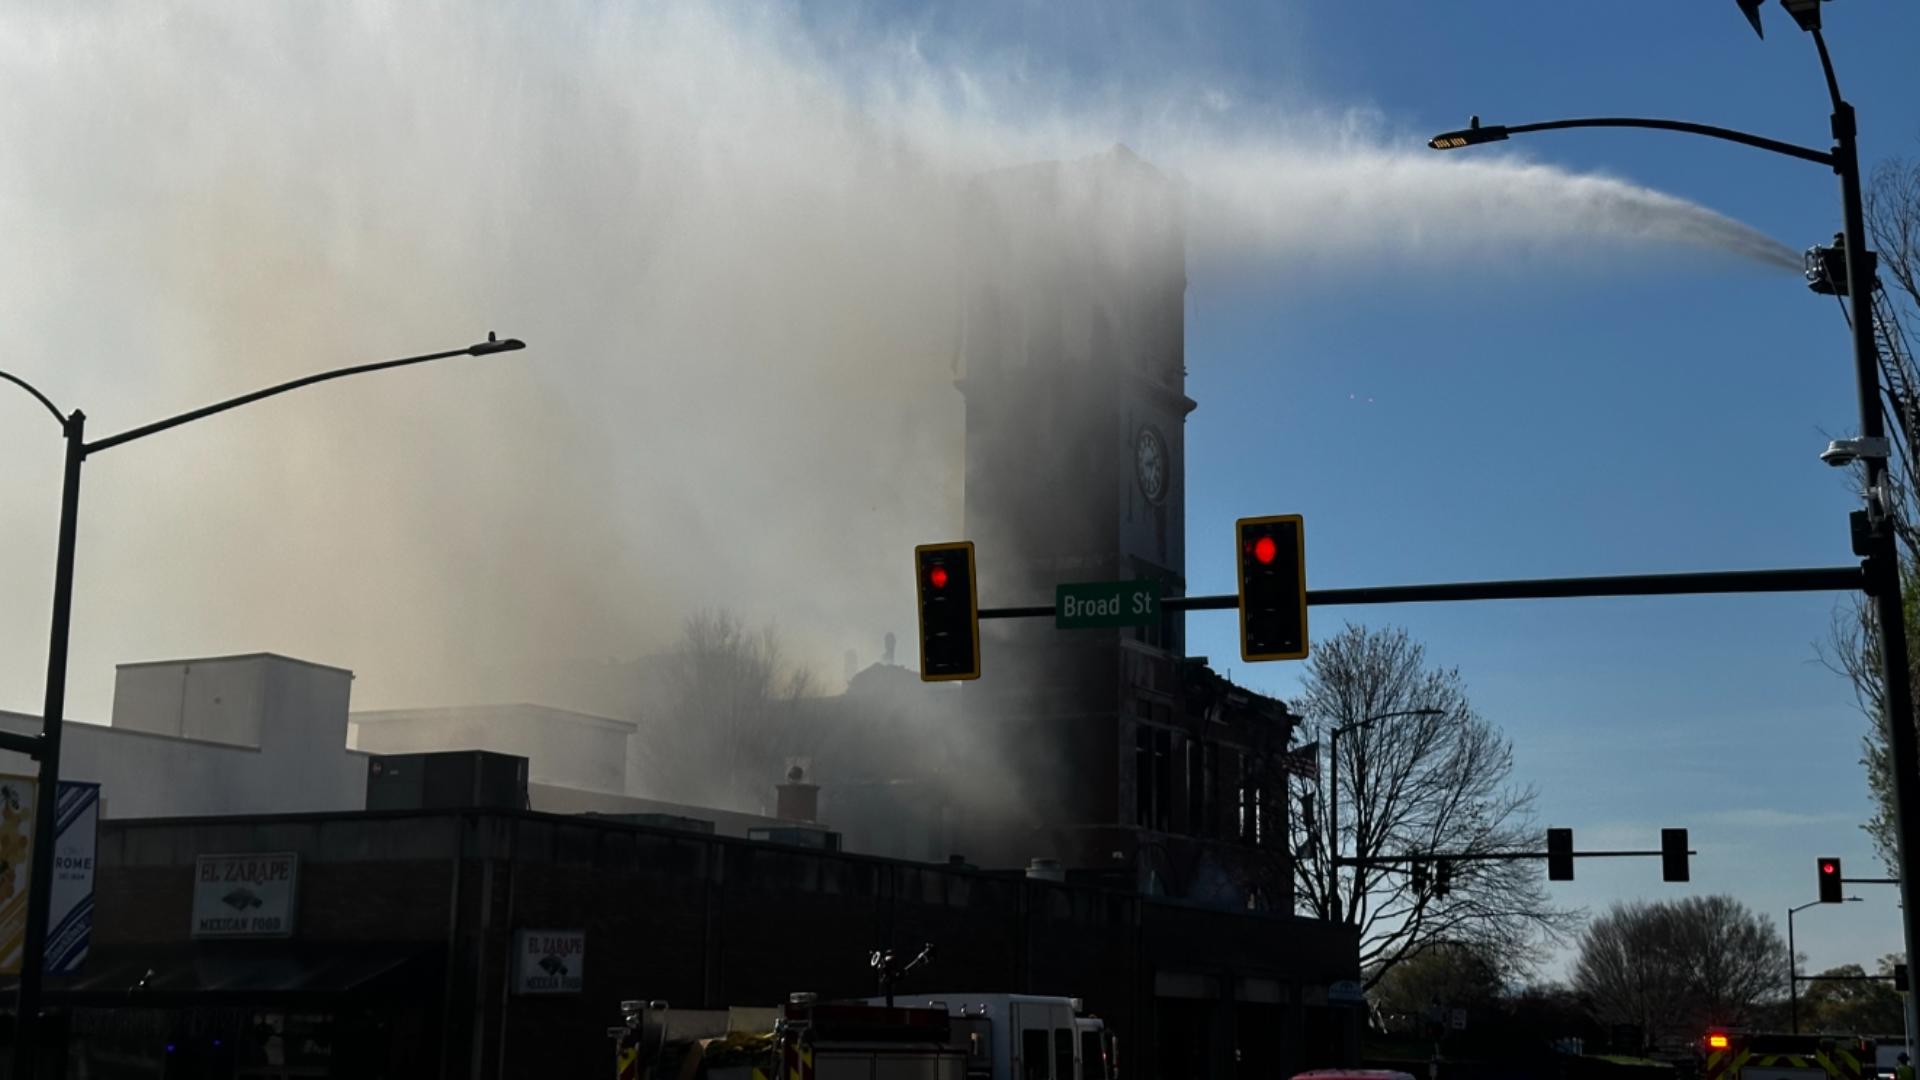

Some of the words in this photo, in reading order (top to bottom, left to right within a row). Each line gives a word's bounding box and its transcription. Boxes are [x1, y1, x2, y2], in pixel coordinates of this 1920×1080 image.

[1063, 593, 1120, 617] Broad
[1131, 591, 1152, 615] St
[55, 856, 92, 870] ROME
[200, 863, 220, 881] EL
[224, 861, 289, 885] ZARAPE
[200, 918, 248, 930] MEXICAN
[252, 917, 281, 930] FOOD
[528, 937, 540, 954] EL
[543, 936, 582, 957] ZARAPE
